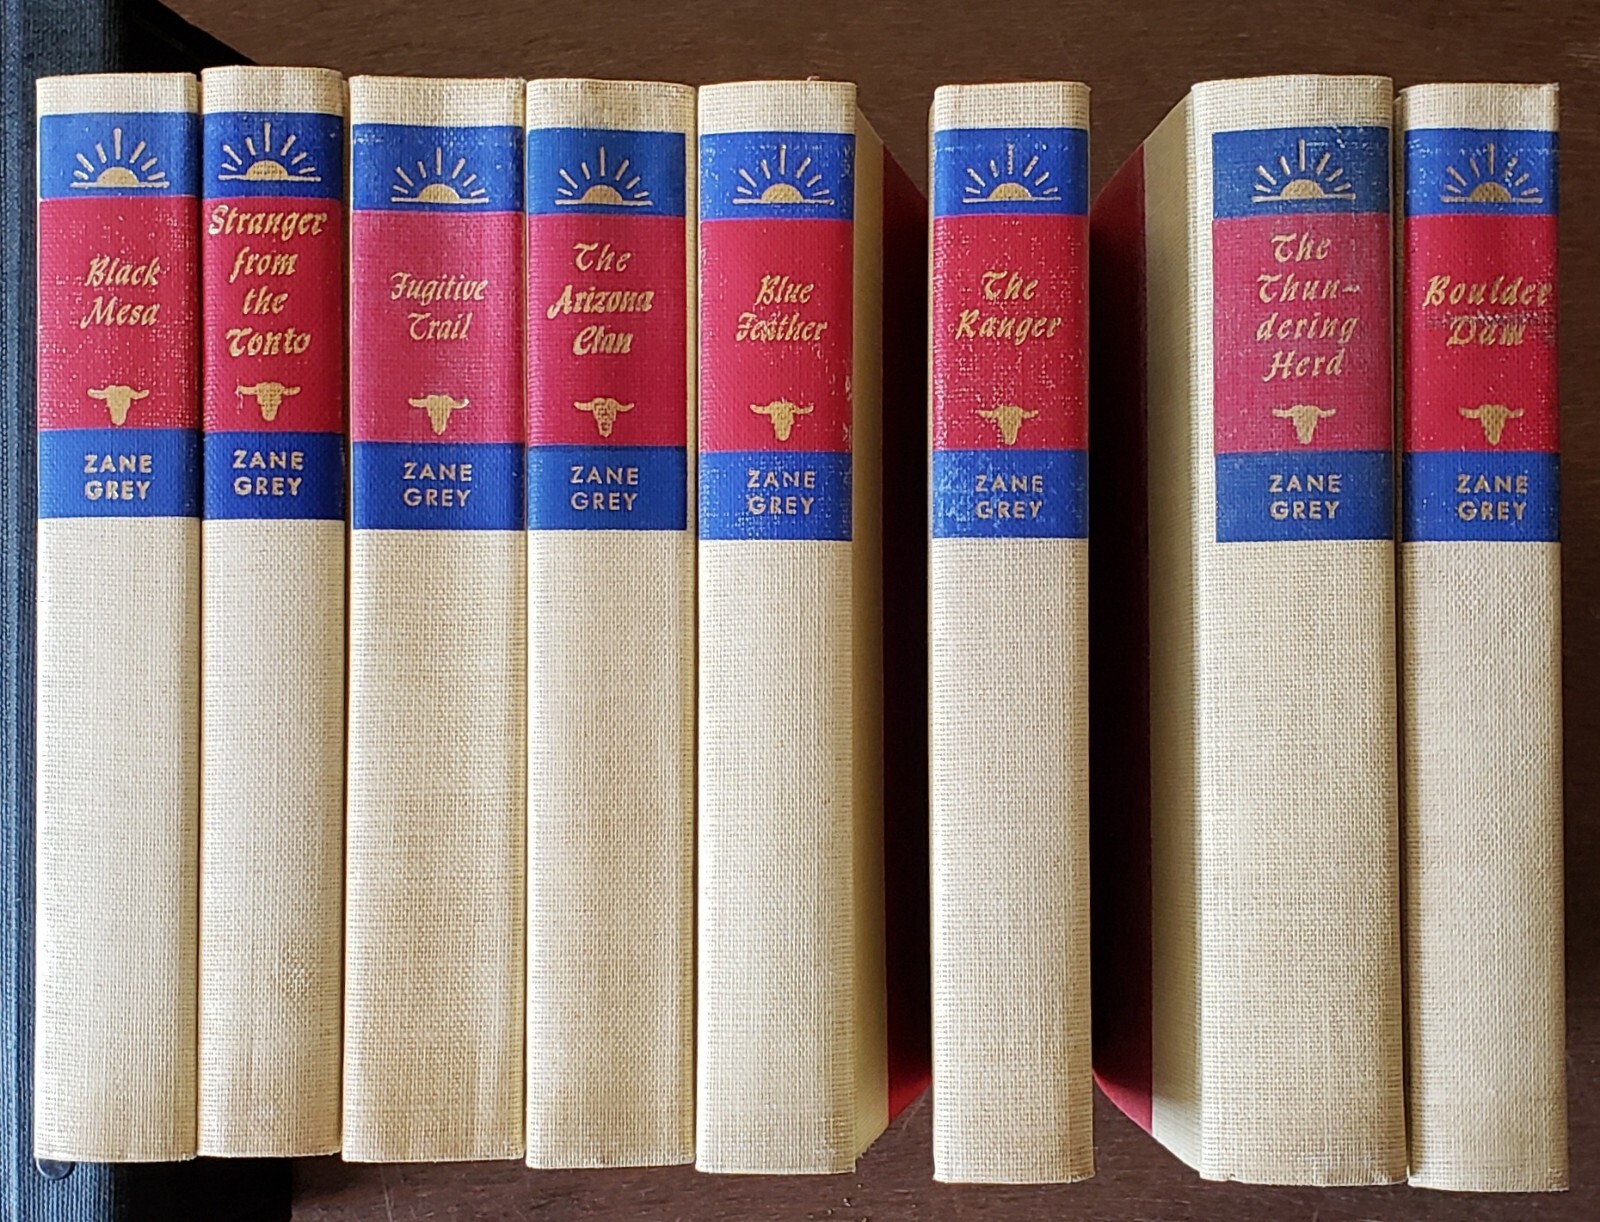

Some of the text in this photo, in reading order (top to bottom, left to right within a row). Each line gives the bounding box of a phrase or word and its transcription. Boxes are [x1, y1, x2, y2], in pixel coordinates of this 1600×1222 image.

[207, 204, 328, 241] Stranger
[573, 242, 632, 272] The
[1271, 232, 1331, 263] The
[85, 257, 161, 289] Black
[229, 247, 298, 283] from
[390, 271, 489, 306] Fugitive
[754, 274, 814, 306] Blue
[981, 270, 1039, 301] The
[1256, 273, 1361, 304] Thun-
[1422, 275, 1553, 307] Boulder
[80, 296, 160, 330] Mesa
[241, 287, 285, 315] the
[546, 284, 655, 319] Arizona
[407, 312, 473, 341] Trail
[572, 325, 634, 356] Clan
[735, 311, 828, 342] Feather
[955, 308, 1062, 345] Ranger
[1256, 312, 1359, 343] dering
[1446, 315, 1527, 347] Dam
[225, 328, 311, 358] Tonto
[1261, 349, 1346, 383] Herd
[84, 454, 153, 474] ZANE
[232, 449, 305, 471] ZANE
[403, 462, 472, 481] ZANE
[84, 479, 151, 501] GREY
[233, 476, 304, 497] GREY
[570, 466, 639, 486] ZANE
[747, 470, 816, 490] ZANE
[975, 474, 1044, 493] ZANE
[1269, 474, 1343, 493] ZANE
[1456, 474, 1528, 495] ZANE
[403, 488, 471, 507] GREY
[570, 491, 638, 511] GREY
[748, 496, 815, 515] GREY
[975, 501, 1043, 519] GREY
[1270, 501, 1340, 520] GREY
[1457, 501, 1528, 521] GREY
